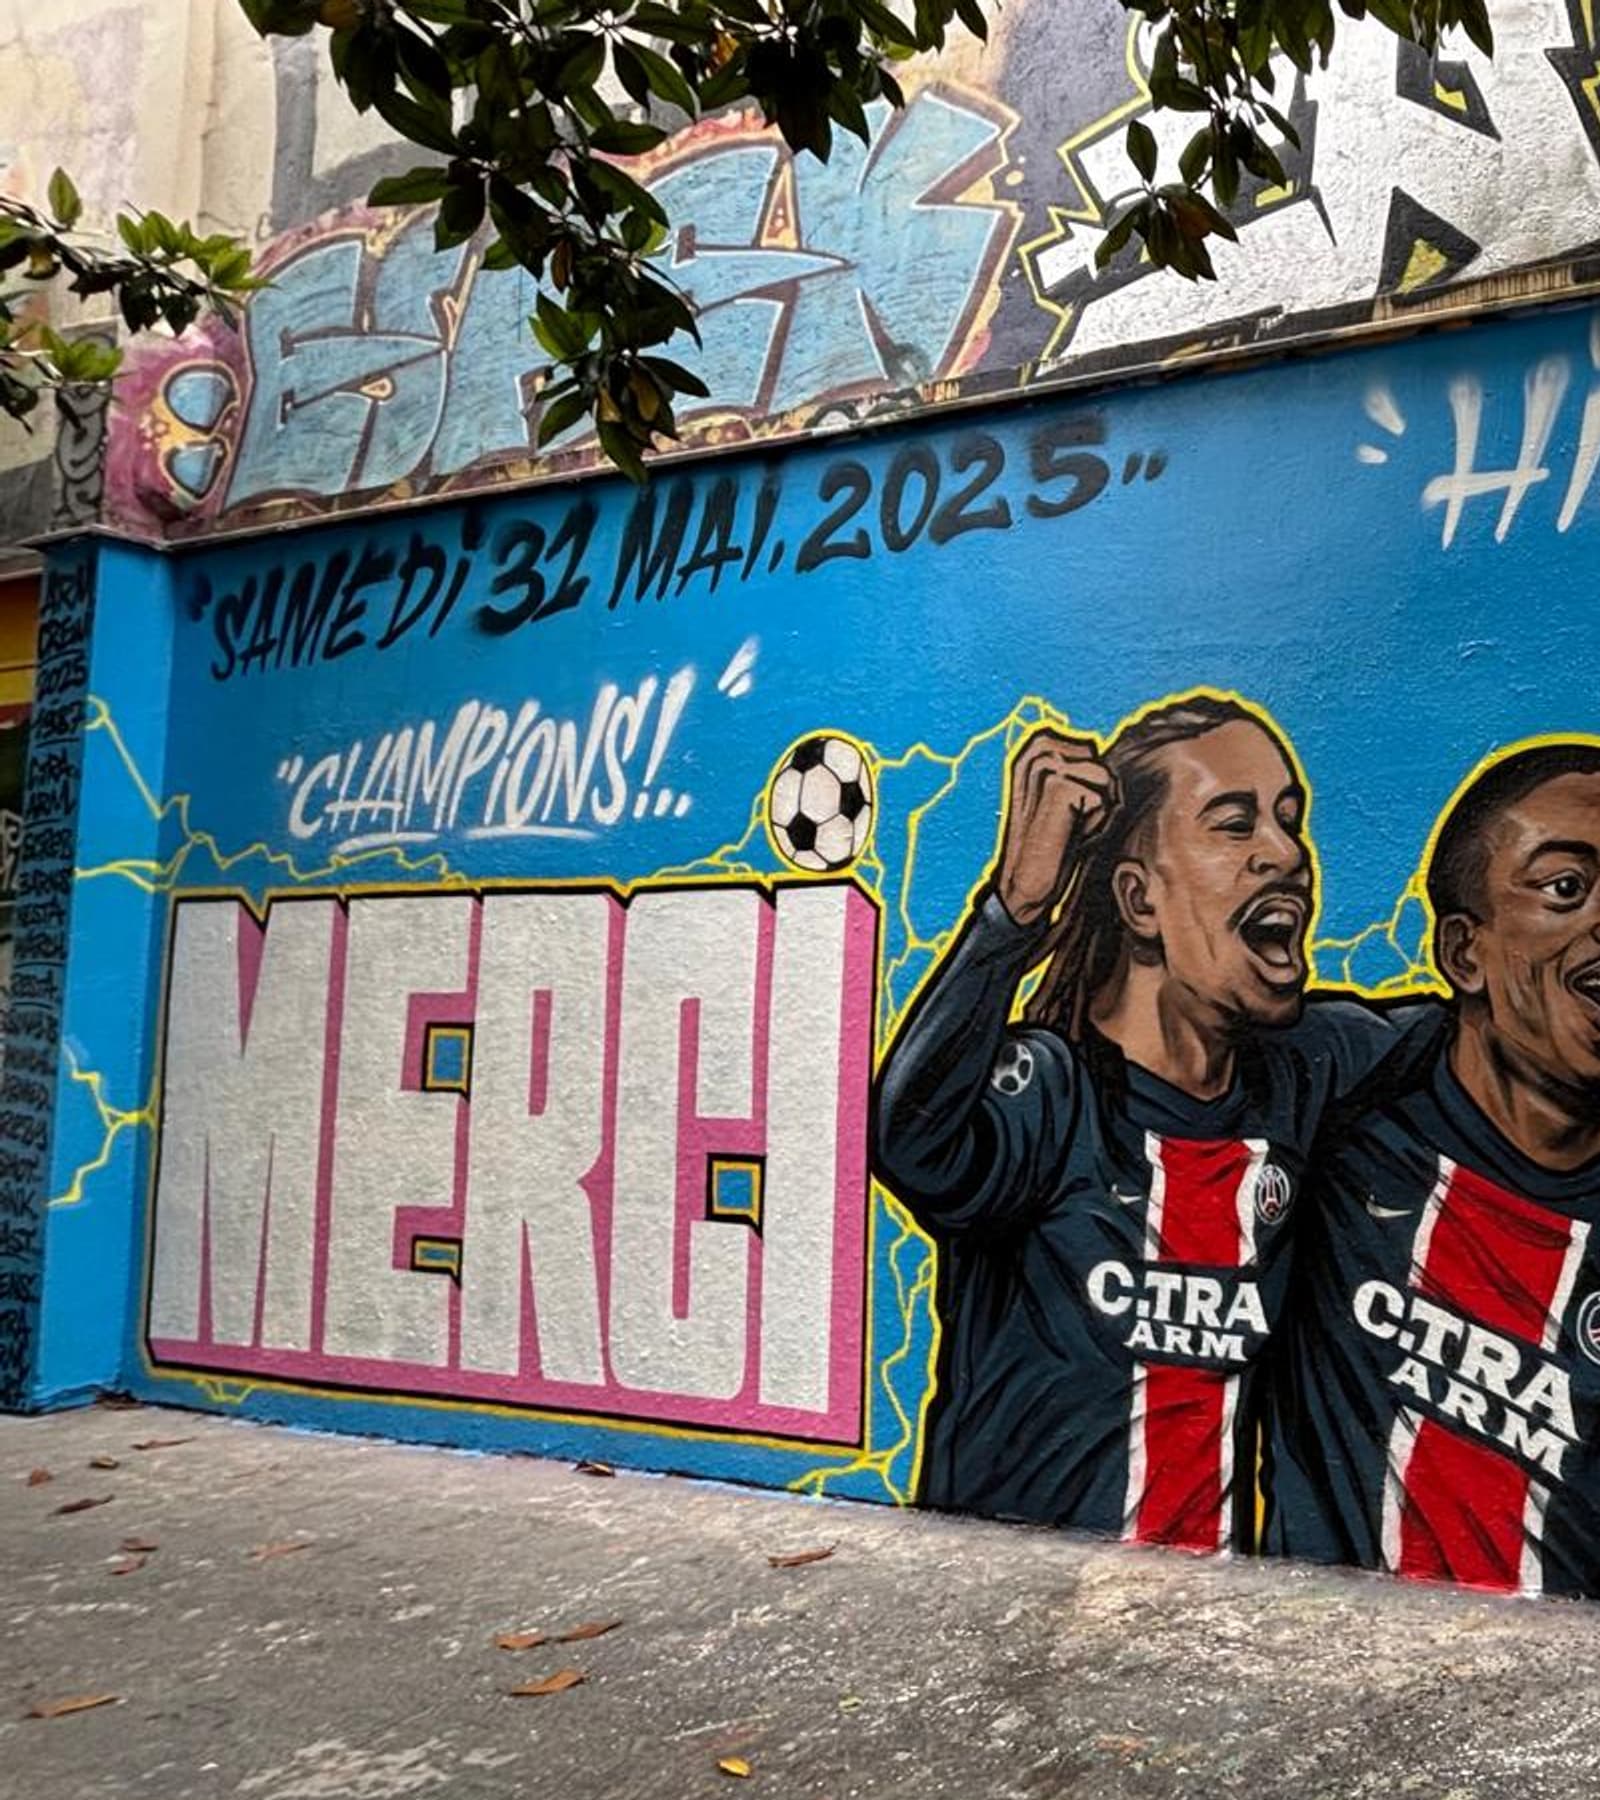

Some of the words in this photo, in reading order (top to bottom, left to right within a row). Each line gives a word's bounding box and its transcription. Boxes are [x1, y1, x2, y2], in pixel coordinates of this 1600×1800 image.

[472, 500, 599, 636] 31
[148, 882, 875, 1440] MERCI
[1087, 1260, 1271, 1334] C.TRA
[1123, 1319, 1249, 1362] ARM
[1353, 1280, 1583, 1441] C.TRA
[1388, 1356, 1571, 1481] ARM
